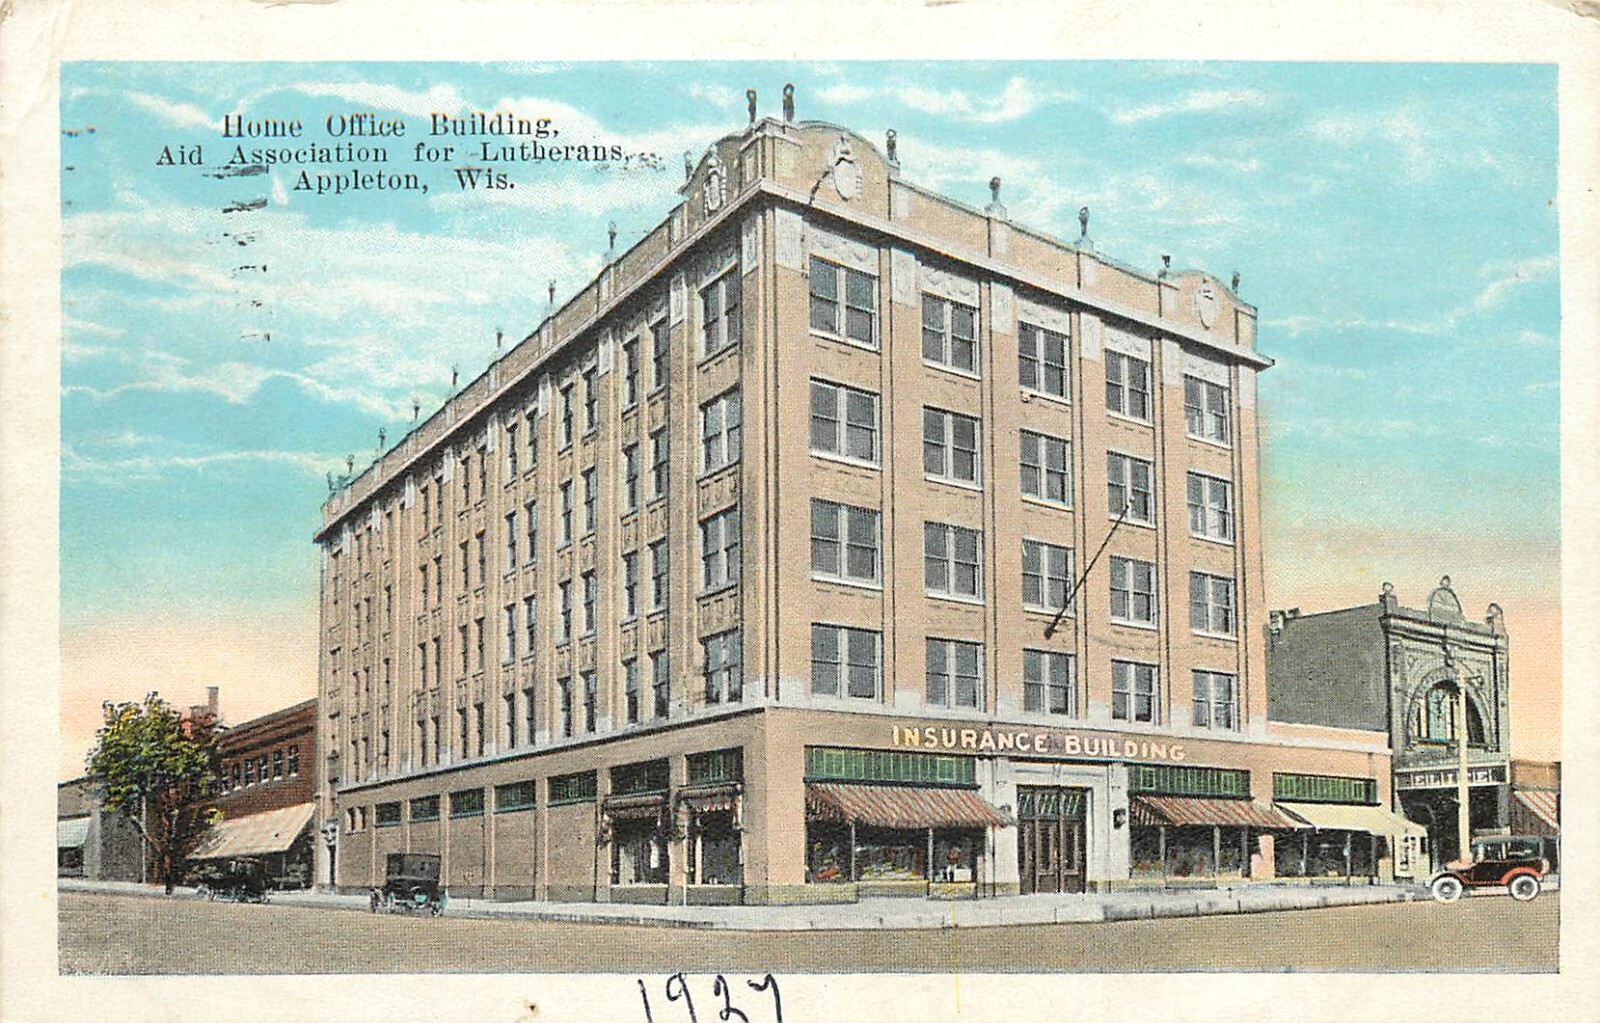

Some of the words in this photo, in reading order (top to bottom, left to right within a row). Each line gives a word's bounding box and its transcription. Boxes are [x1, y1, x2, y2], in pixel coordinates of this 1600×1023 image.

[893, 725, 1049, 752] INSURANCE
[1065, 735, 1186, 761] BUILDING
[1414, 770, 1489, 787] ELIE
[637, 973, 783, 1023] 1927
